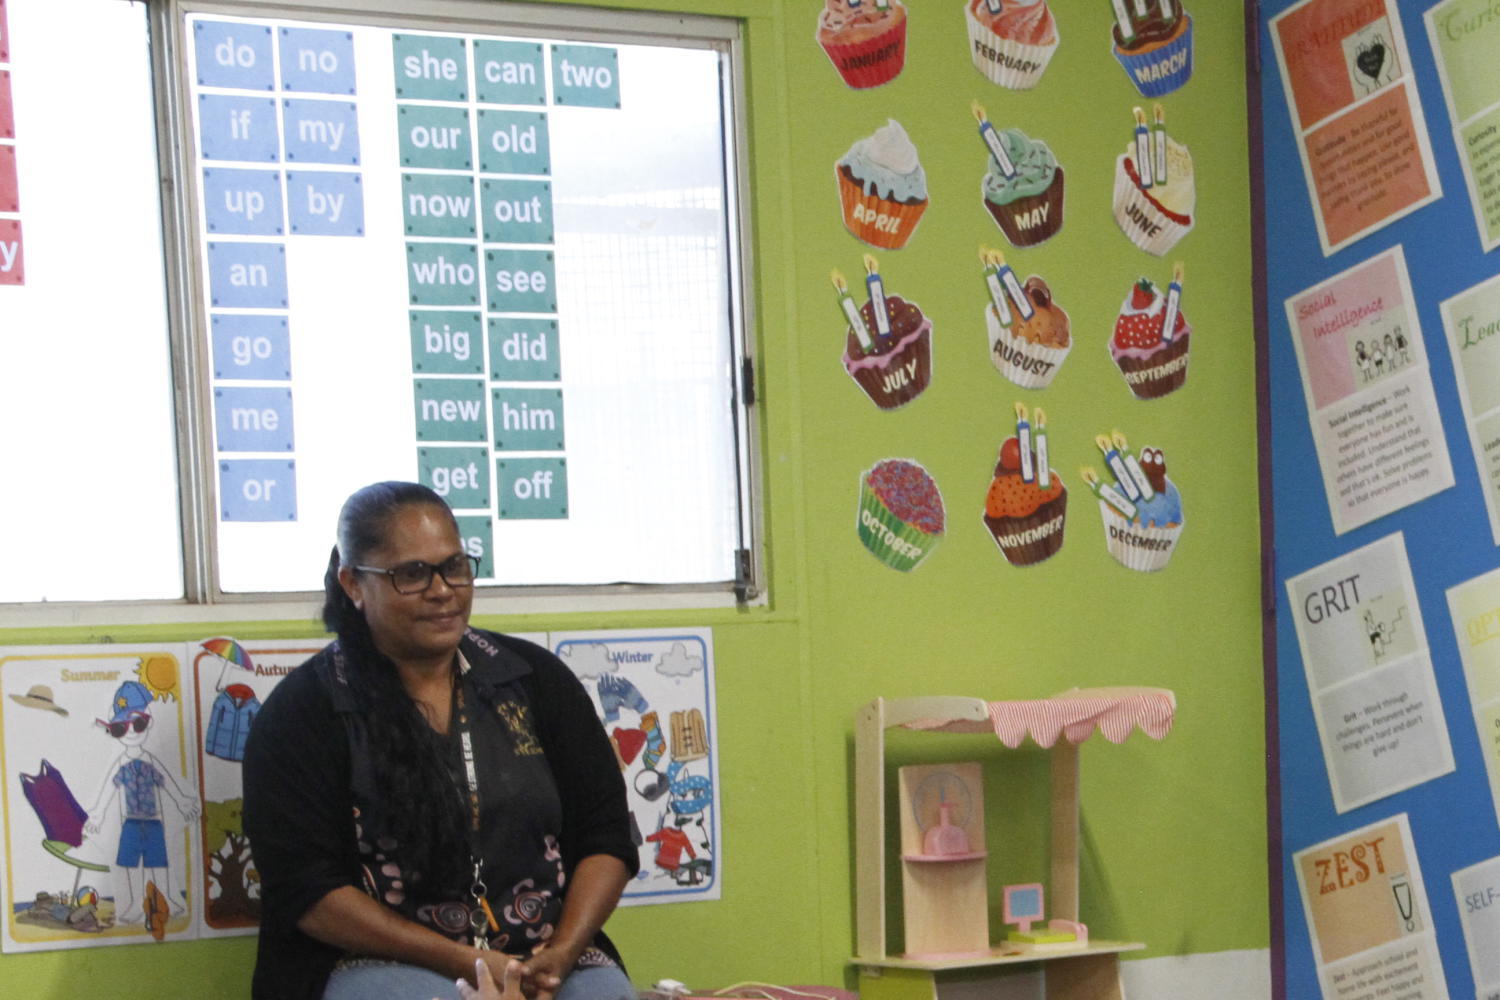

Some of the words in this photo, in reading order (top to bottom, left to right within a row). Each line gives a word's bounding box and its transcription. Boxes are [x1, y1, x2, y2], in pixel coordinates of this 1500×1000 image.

[215, 38, 256, 68] do
[299, 49, 338, 73] no
[404, 49, 458, 81] she
[841, 44, 899, 70] JANUARY
[974, 40, 1041, 74] FEBRUARY
[1134, 47, 1187, 85] MARCH
[484, 60, 536, 85] can
[560, 59, 612, 89] two
[231, 109, 251, 140] if
[298, 119, 345, 151] my
[410, 125, 462, 149] our
[492, 124, 537, 154] old
[225, 190, 265, 221] up
[307, 184, 345, 223] by
[409, 193, 471, 218] now
[494, 196, 543, 223] out
[1014, 202, 1050, 231] MAY
[852, 203, 900, 235] APRIL
[1124, 202, 1162, 239] JUNE
[229, 263, 268, 287] an
[412, 255, 475, 285] who
[496, 270, 547, 293] see
[231, 335, 272, 366] go
[424, 324, 471, 361] big
[502, 332, 547, 361] did
[993, 340, 1055, 377] AUGUST
[1124, 353, 1187, 385] SEPTEMBER
[882, 359, 918, 394] JULY
[231, 407, 279, 431] me
[421, 399, 481, 422] new
[502, 402, 555, 430] him
[242, 479, 276, 502] or
[432, 462, 479, 496] get
[513, 470, 553, 499] off
[861, 510, 923, 560] OCTOBER
[998, 515, 1063, 549] NOVEMBER
[1109, 525, 1172, 552] DECEMBER
[1304, 573, 1360, 625] GRIT
[255, 663, 300, 677] Autu
[612, 650, 654, 664] Winter
[60, 667, 120, 682] Summer
[1315, 837, 1386, 895] ZEST
